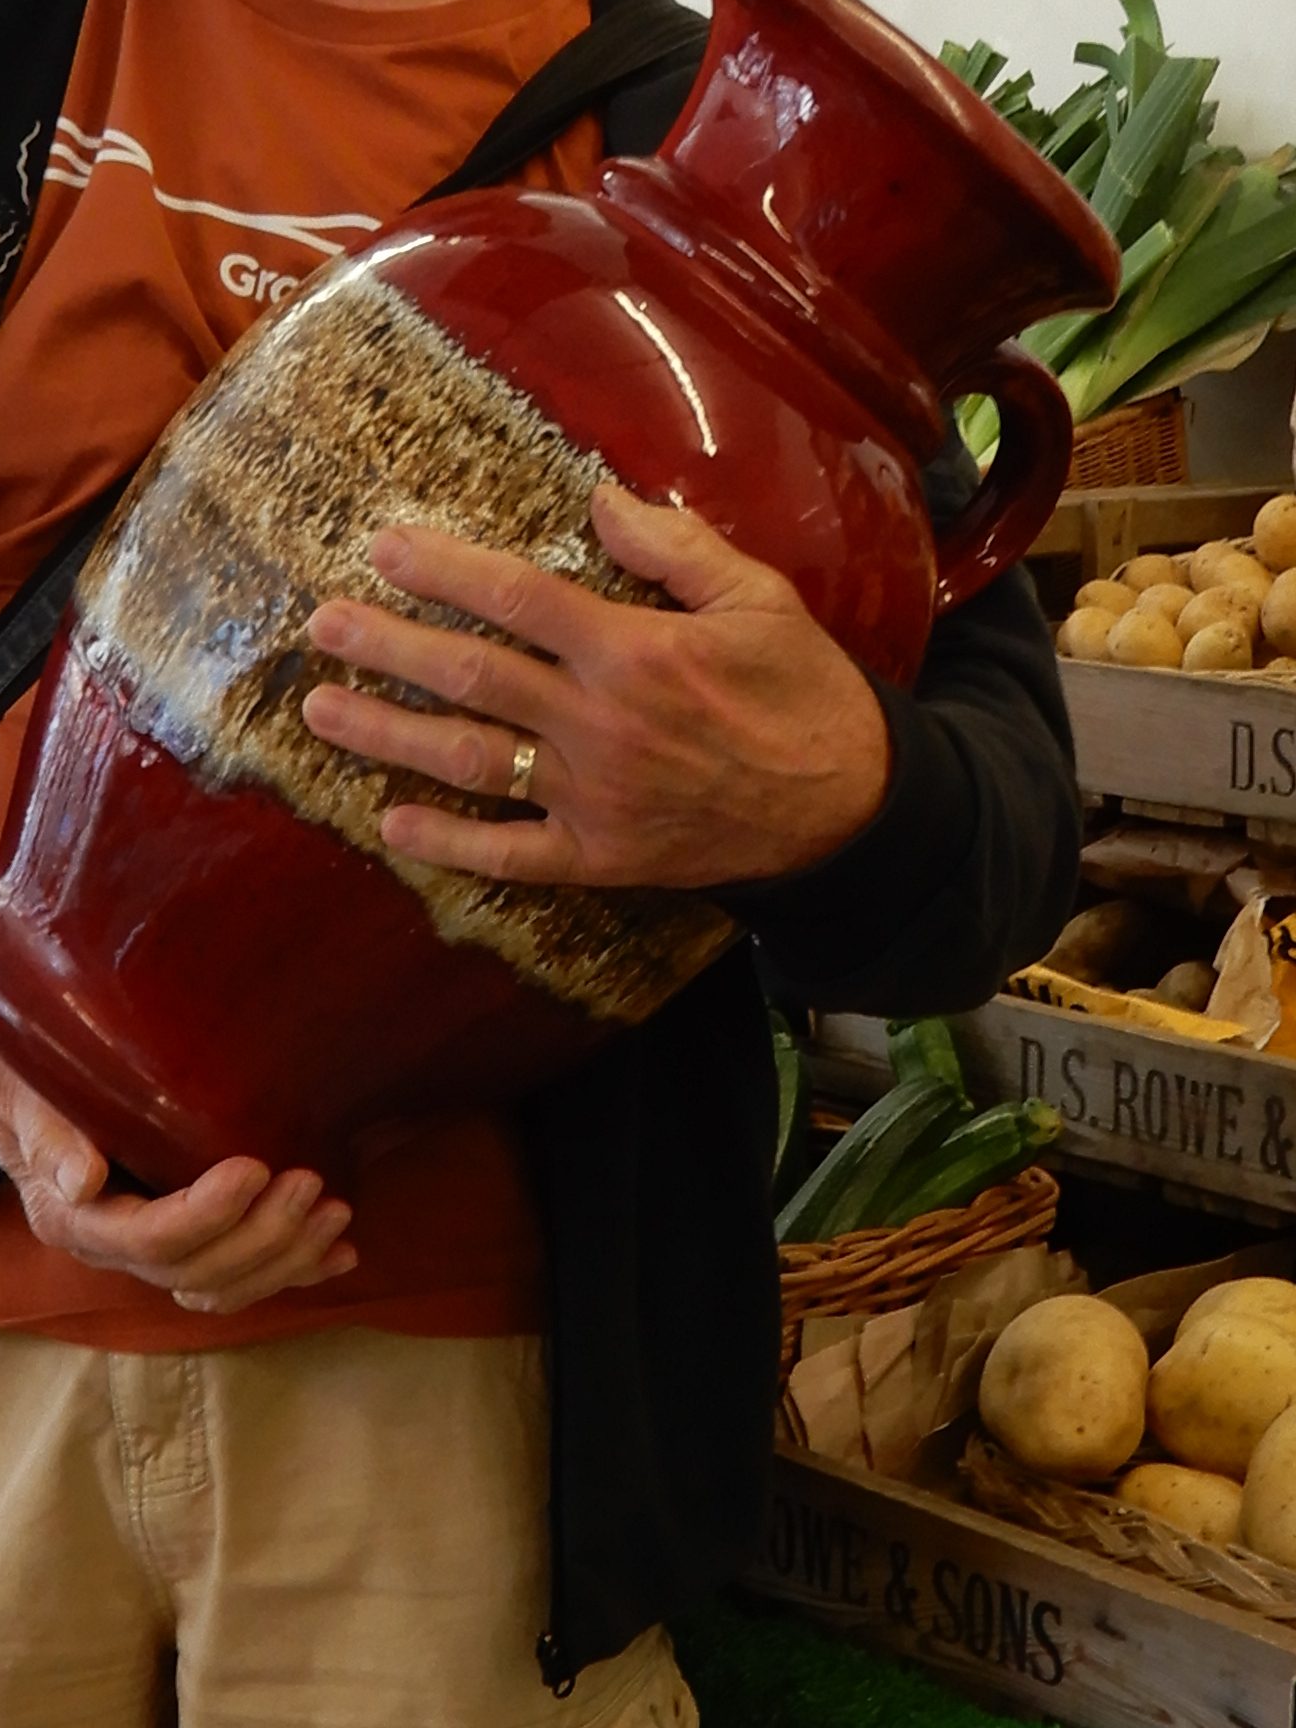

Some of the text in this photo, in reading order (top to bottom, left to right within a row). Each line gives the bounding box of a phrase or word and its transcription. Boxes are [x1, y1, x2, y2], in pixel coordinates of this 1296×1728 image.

[1019, 1035, 1244, 1163] DS.ROWE
[1259, 1094, 1295, 1180] &
[884, 1540, 919, 1628] &
[932, 1559, 1065, 1687] SONS
